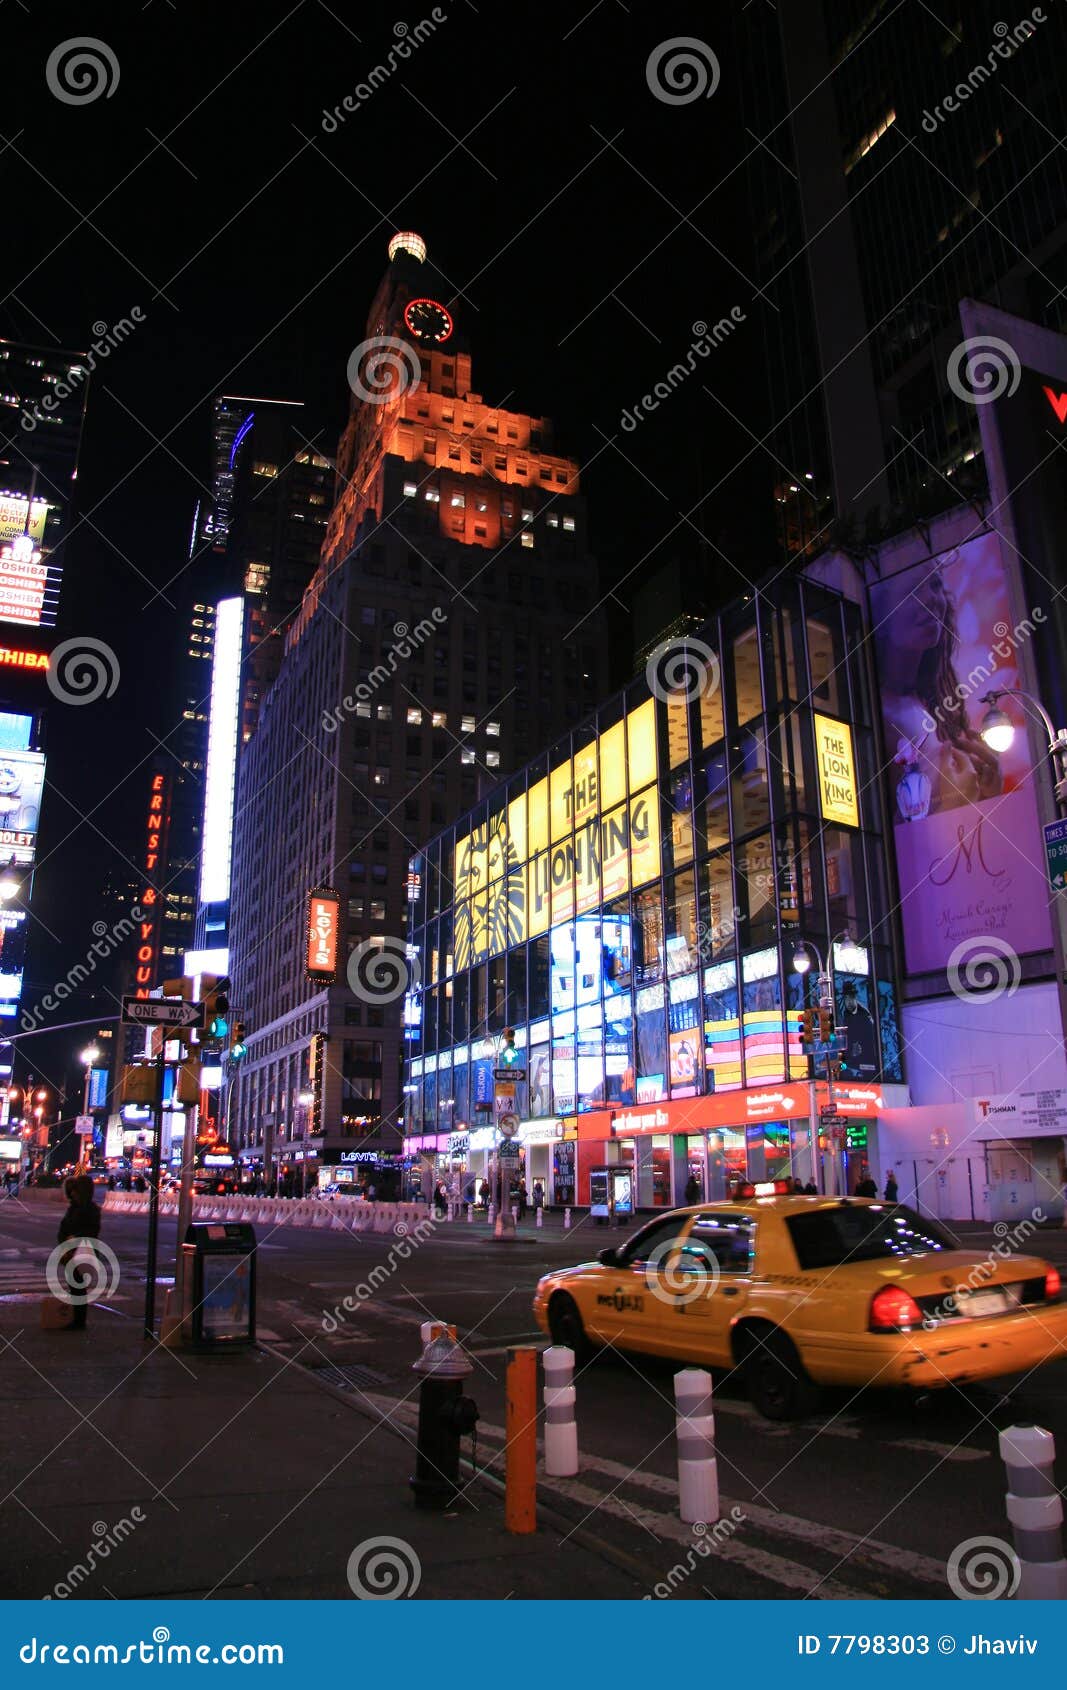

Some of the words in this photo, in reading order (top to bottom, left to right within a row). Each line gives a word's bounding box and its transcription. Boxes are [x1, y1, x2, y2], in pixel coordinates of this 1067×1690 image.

[1, 562, 46, 576] OSHIBA
[0, 575, 45, 590] OSHIBA
[824, 736, 844, 754] THE
[822, 753, 849, 778] LION
[563, 770, 597, 818] THE
[824, 780, 853, 806] KING
[147, 775, 164, 870] ERNST
[534, 838, 582, 914] LION
[585, 799, 650, 886] KING
[143, 889, 156, 904] &
[136, 923, 153, 999] YOUN
[134, 1005, 158, 1017] ONE
[168, 1007, 193, 1019] WAY
